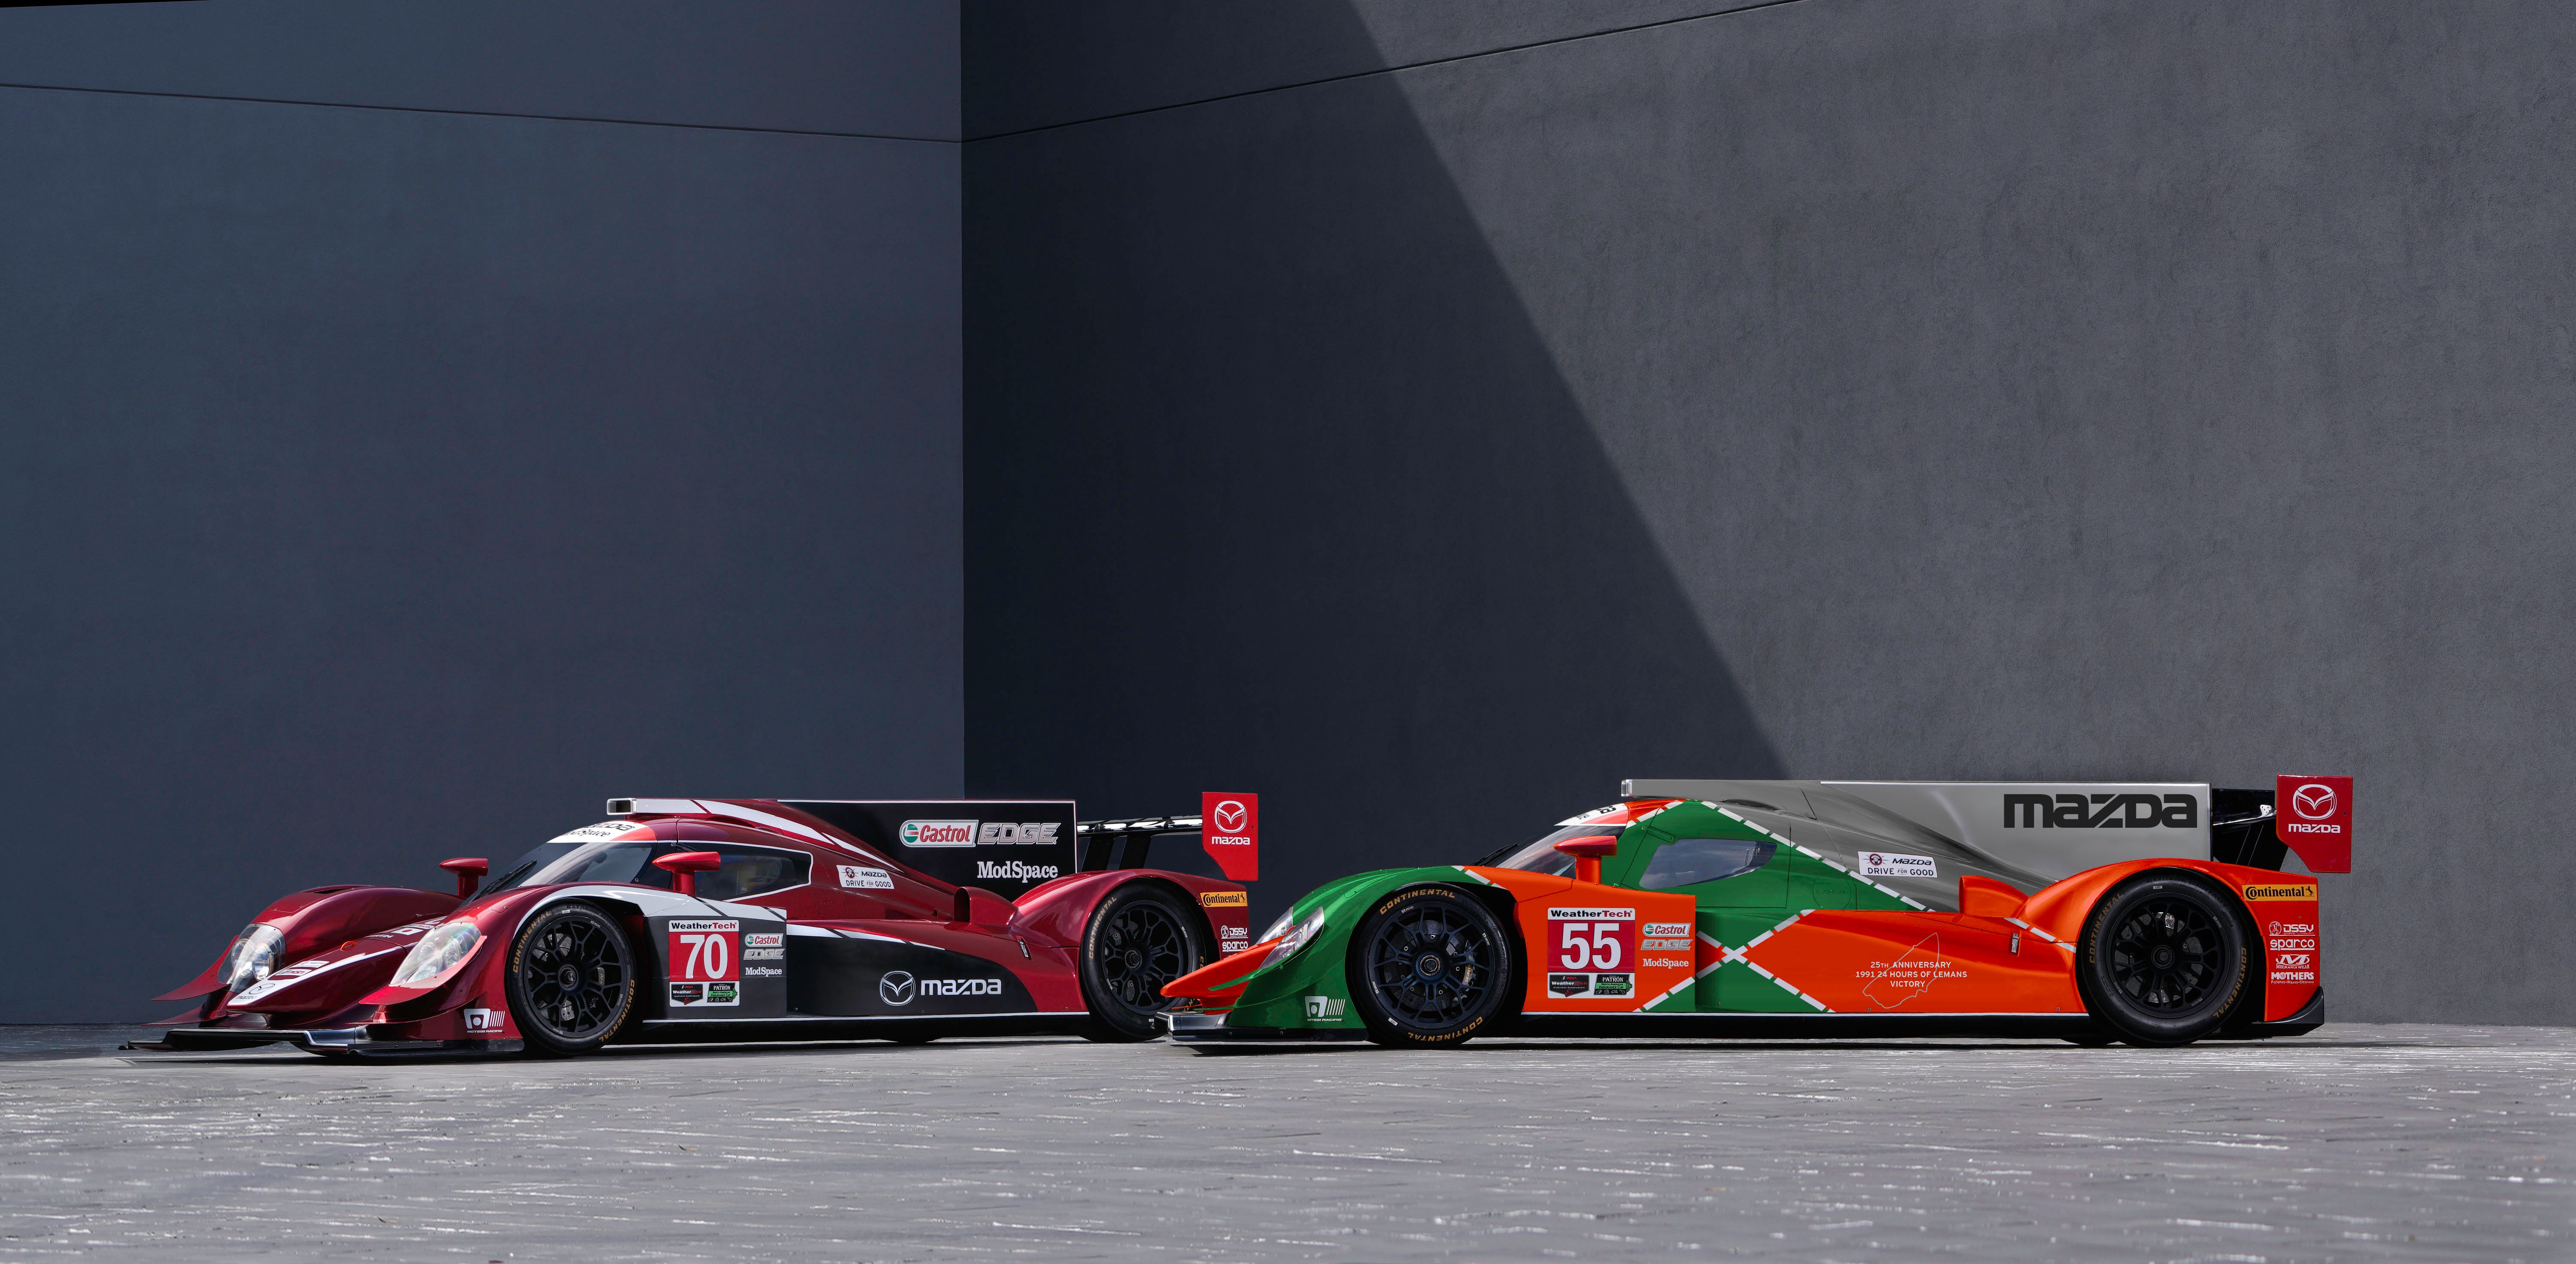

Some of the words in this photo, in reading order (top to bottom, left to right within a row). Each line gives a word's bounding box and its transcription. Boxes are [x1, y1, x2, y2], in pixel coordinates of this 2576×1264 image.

[920, 824, 971, 842] Castrol
[977, 822, 1062, 845] EDGE
[977, 861, 1058, 883] ModSpace
[1203, 893, 1240, 906] Continental
[2245, 886, 2305, 900] Continental
[1380, 888, 1455, 915] CONTINENTAL
[1088, 896, 1117, 960] CONTINENTAL
[1229, 927, 1248, 936] DSSV
[1655, 925, 1686, 934] Castrol
[2089, 892, 2124, 964] CONTINENTAL
[2283, 924, 2314, 933] DSSV
[513, 910, 552, 973] CONTINENTAL
[754, 936, 780, 945] Castrol
[1222, 941, 1249, 952] sparco
[1561, 923, 1621, 969] 55
[1641, 939, 1693, 951] EDGE
[2270, 939, 2315, 951] sparco
[680, 934, 728, 979] 70
[744, 948, 785, 960] EDGE
[1643, 958, 1689, 969] ModSpace
[745, 966, 782, 977] ModSpace
[2271, 972, 2314, 980] MOTHERS
[2213, 947, 2247, 1018] CONTINENTAL
[598, 979, 635, 1042] CONTINENTAL
[1407, 1016, 1483, 1042] CONTINENTAL
